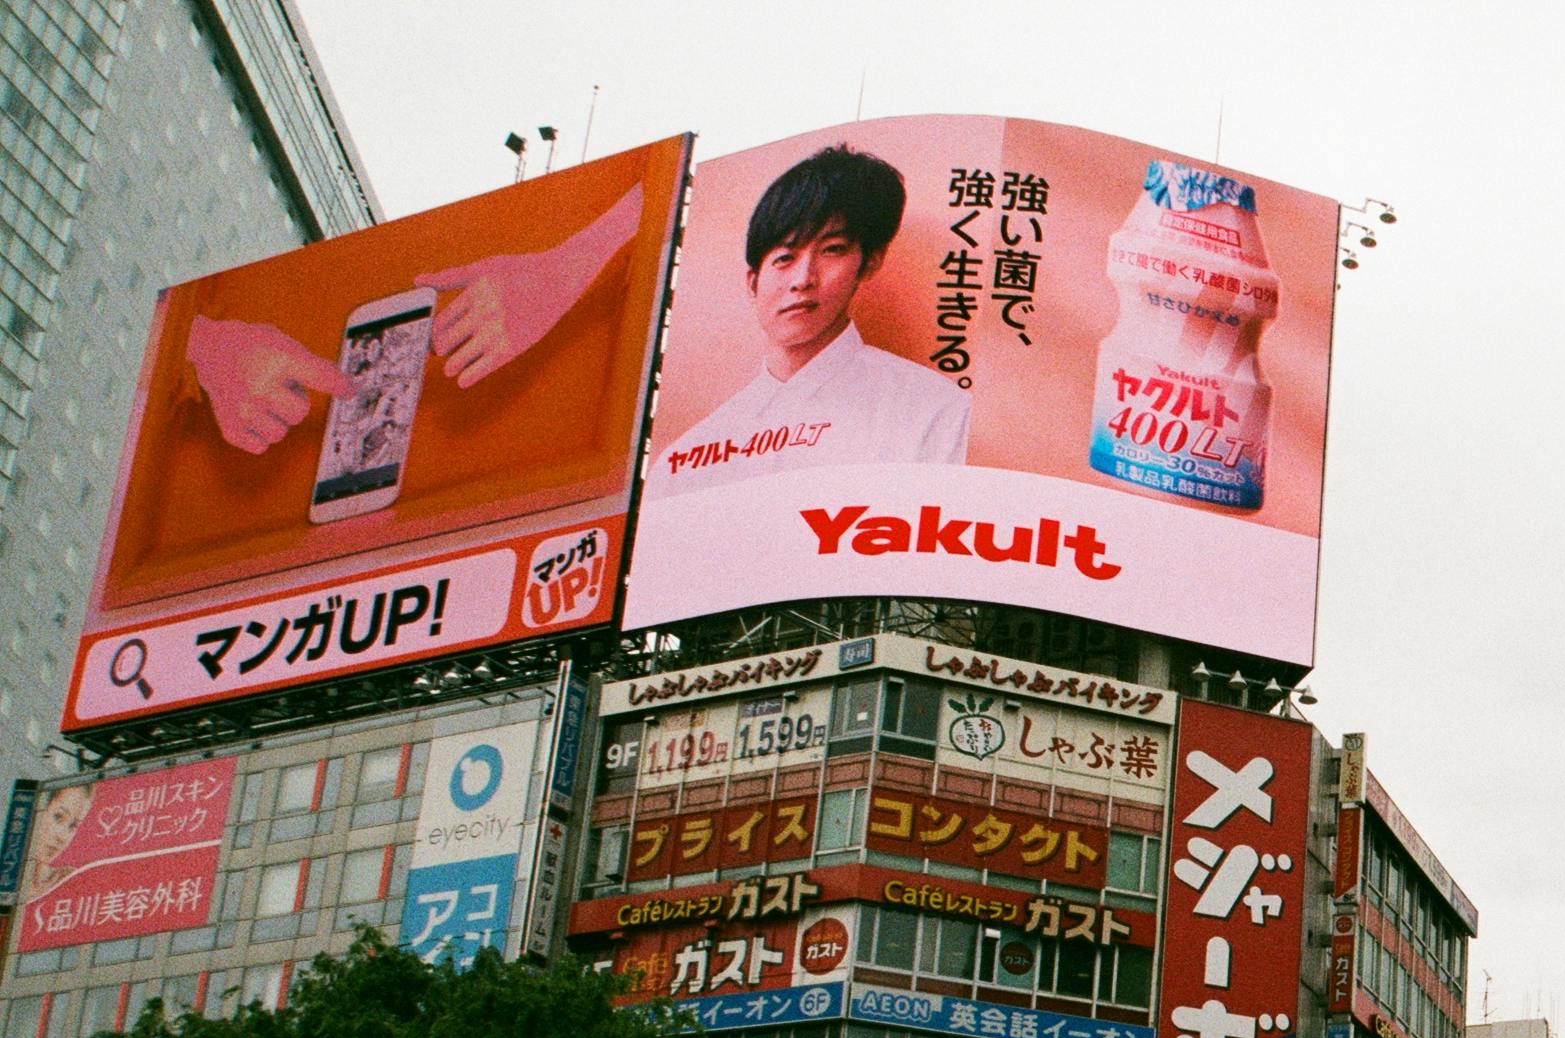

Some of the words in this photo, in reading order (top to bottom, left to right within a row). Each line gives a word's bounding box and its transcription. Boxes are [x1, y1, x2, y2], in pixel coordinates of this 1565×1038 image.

[929, 169, 996, 389] 強く生きる。
[991, 171, 1050, 346] 強い菌で、
[1112, 368, 1240, 428] ヤクルト
[1157, 364, 1221, 390] Yakult
[534, 530, 597, 582] マンガ
[800, 505, 1122, 581] Yakult
[526, 556, 603, 626] UP!
[628, 649, 823, 706] しゃぶしゃぶバイキング
[926, 646, 1164, 715] しゃぶしゃぶバイキング
[605, 741, 640, 769] 9F
[1020, 715, 1160, 780] しゃぶ葉
[123, 776, 225, 816] 品川スキン
[120, 807, 208, 845] クリニック
[428, 814, 511, 849] eyecity
[634, 804, 810, 867] プライス
[870, 798, 1101, 872] コンタクト
[47, 876, 203, 933] 品川美容外科
[727, 874, 819, 920] ガスト
[1025, 898, 1131, 946] ガスト
[671, 936, 784, 996] ガスト
[805, 942, 844, 960] ガスト
[803, 992, 829, 1014] 6F
[861, 992, 931, 1020] AEON
[1334, 956, 1351, 1003] ガスト
